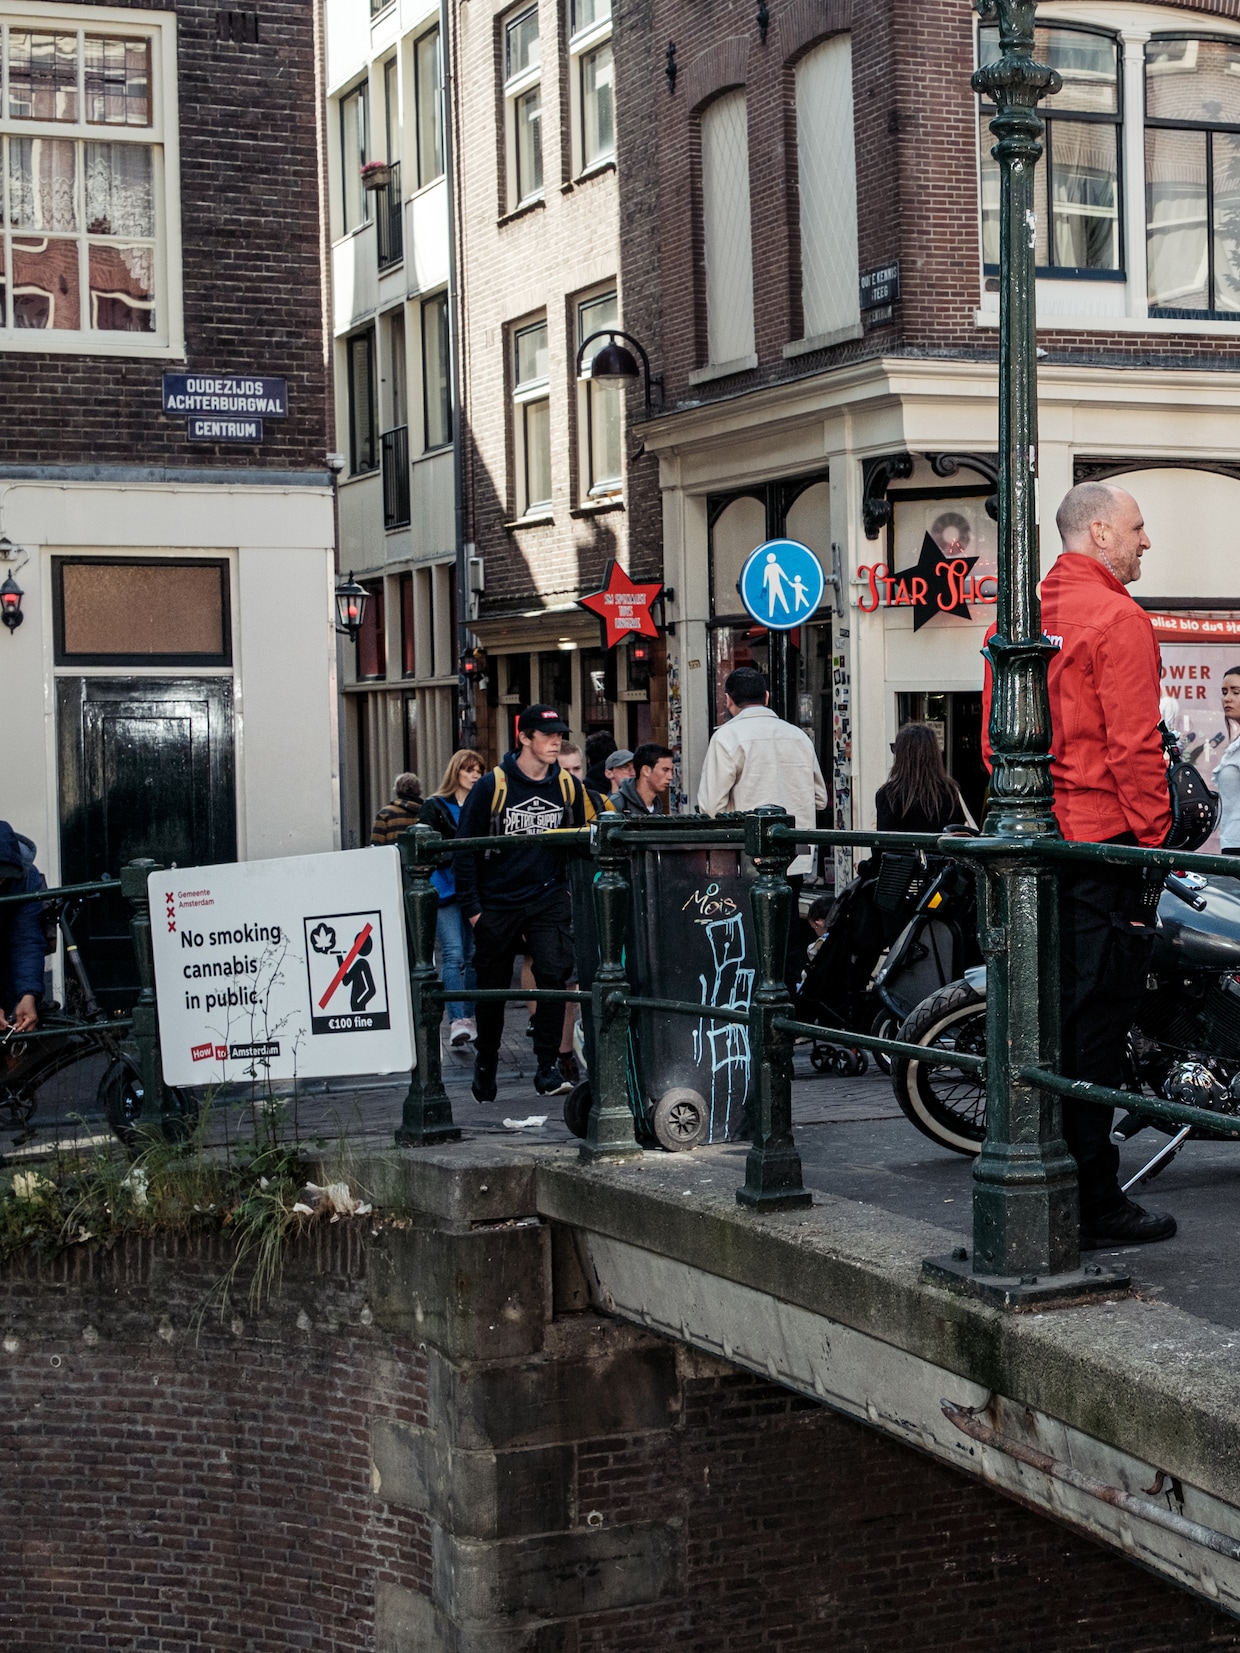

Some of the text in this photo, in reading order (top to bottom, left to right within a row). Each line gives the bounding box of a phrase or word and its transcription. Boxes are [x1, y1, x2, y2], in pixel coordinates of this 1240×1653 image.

[186, 379, 264, 395] OUDEZIJDS
[167, 394, 284, 413] ACHTERBURGWAL
[195, 421, 257, 438] CENTRUM
[935, 559, 999, 611] SHO
[1158, 665, 1211, 680] OWER
[1160, 685, 1207, 699] WER
[177, 889, 211, 899] Gemeente
[178, 898, 215, 908] Amsterdam
[181, 922, 281, 948] No smoking
[183, 954, 258, 979] cannabis
[185, 986, 264, 1013] in public.
[328, 1015, 374, 1030] €100 fine
[192, 1045, 280, 1059] How to Amsterdam
